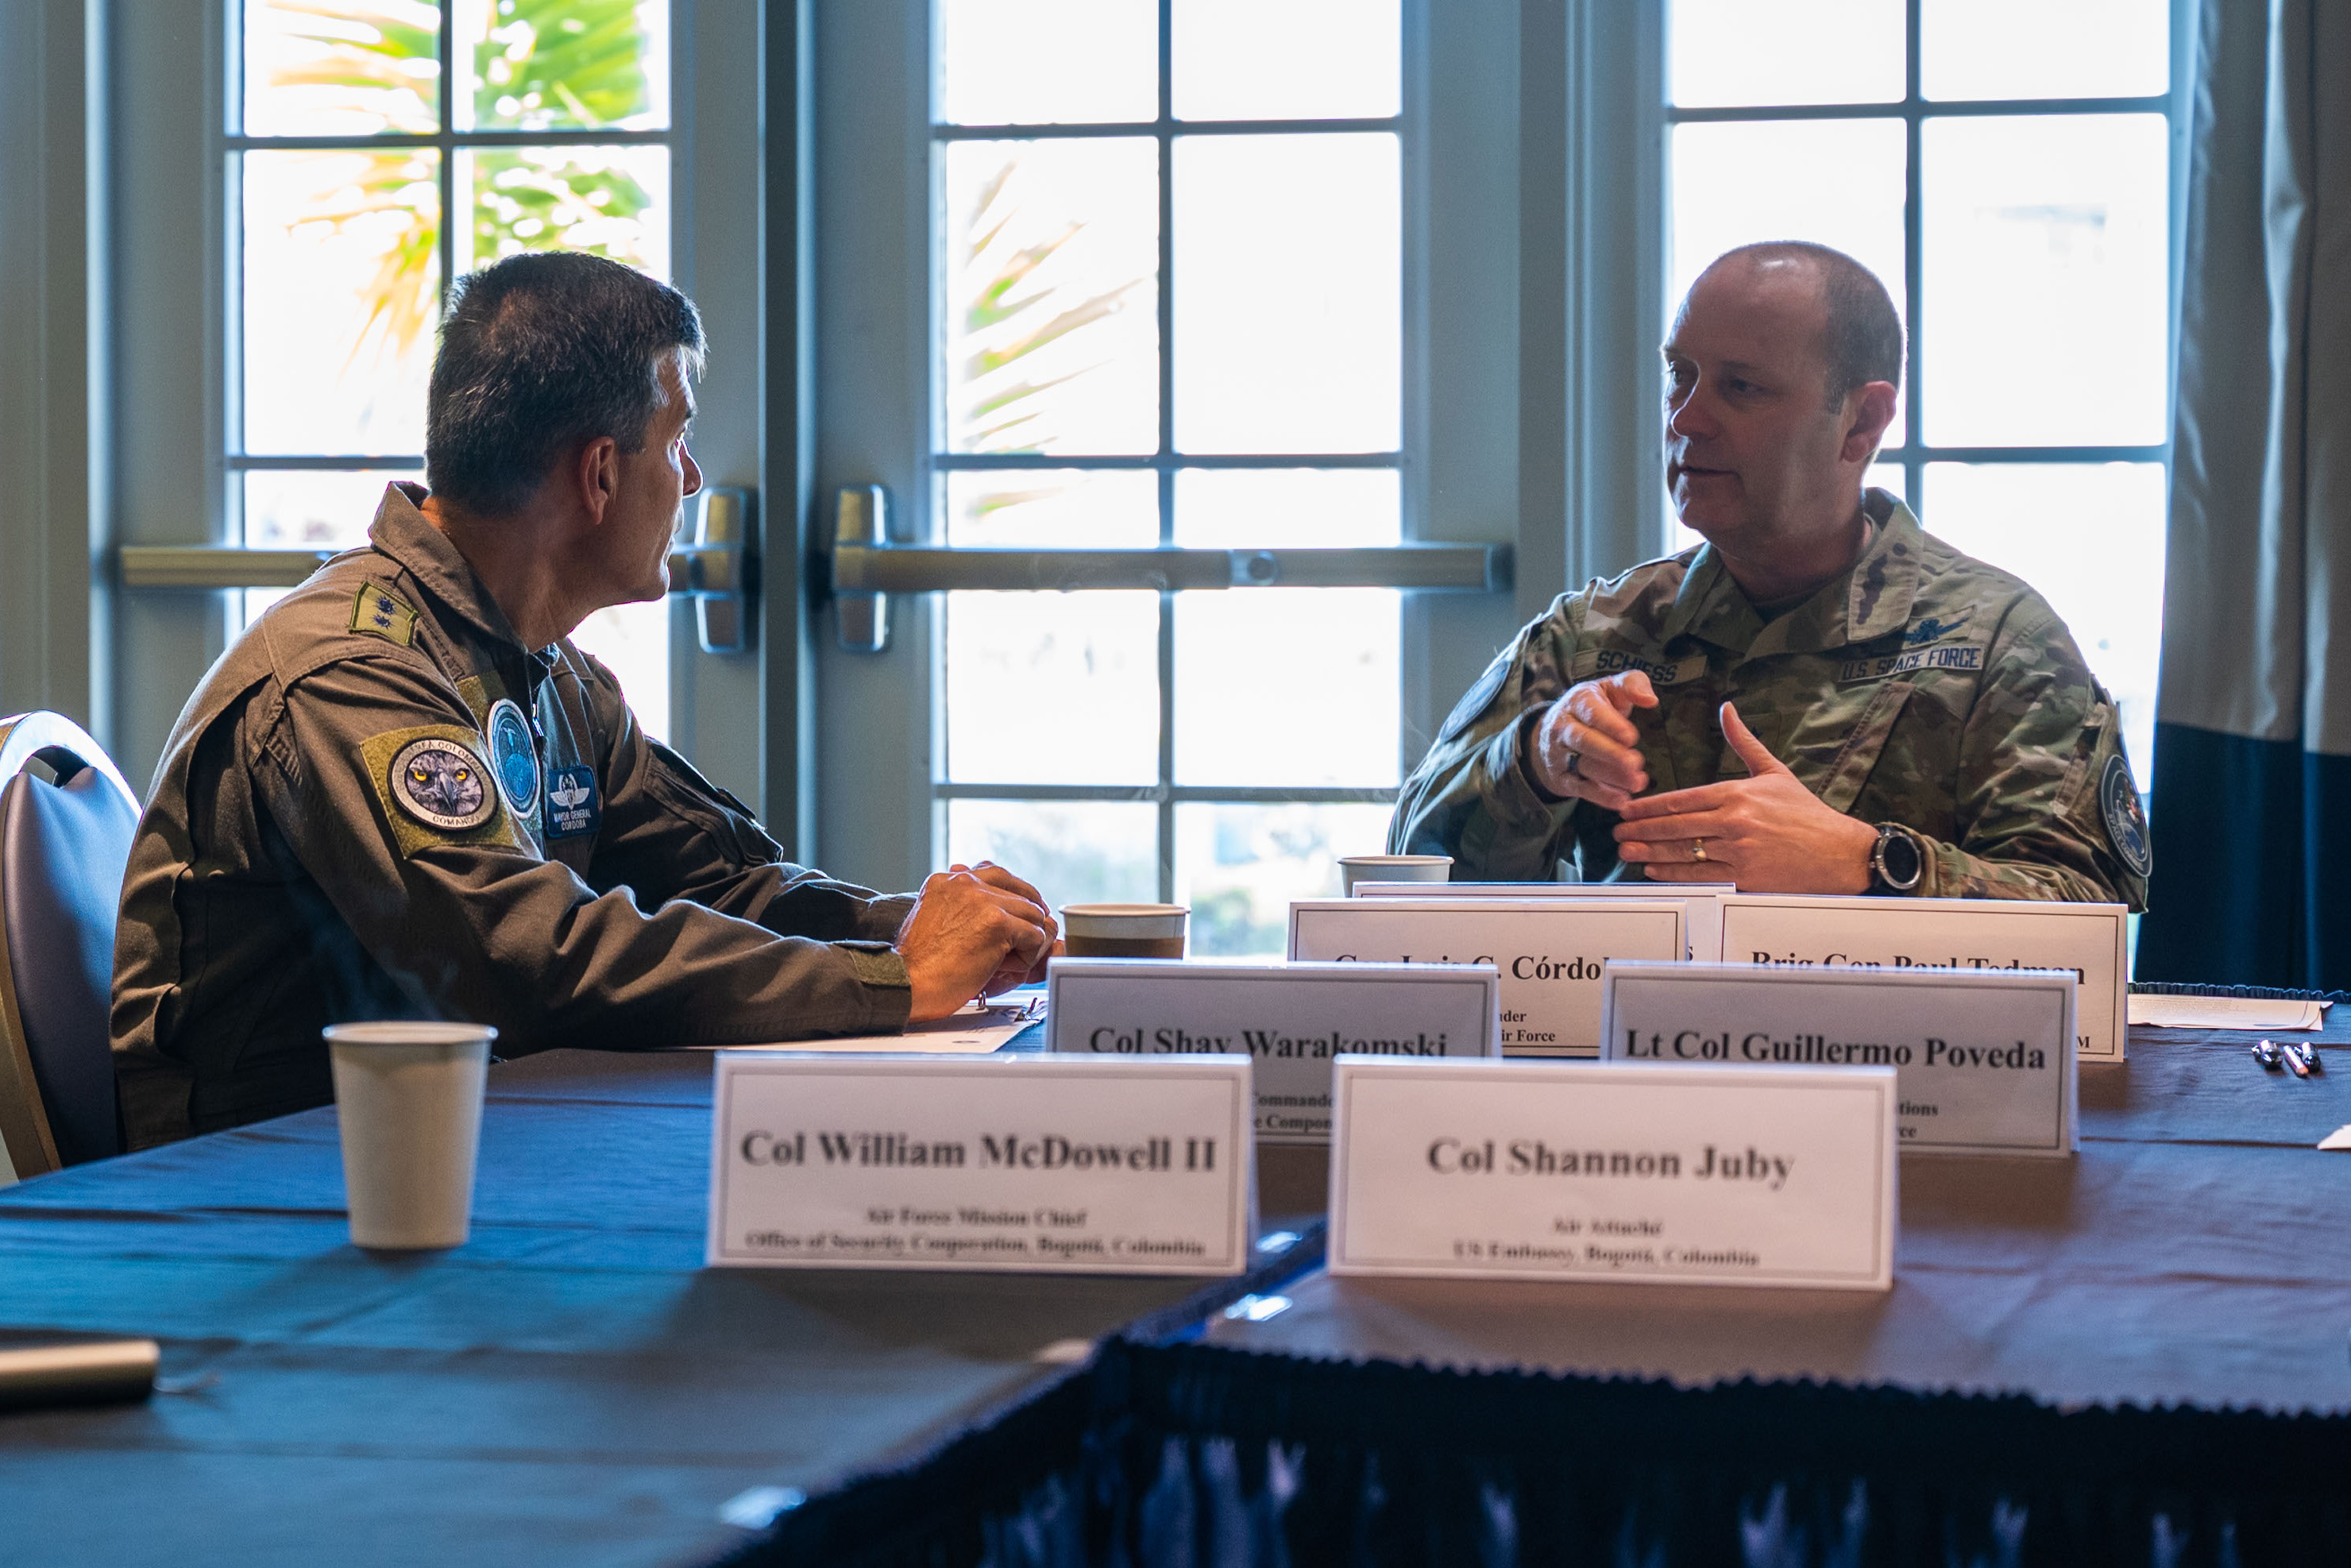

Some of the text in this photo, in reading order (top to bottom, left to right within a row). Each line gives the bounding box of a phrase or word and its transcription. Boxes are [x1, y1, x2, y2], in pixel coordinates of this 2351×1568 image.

[1596, 650, 1677, 682] SCHIESS
[1875, 653, 1925, 675] SPACE
[1927, 647, 1981, 668] FORCE
[570, 809, 591, 820] GENERAL
[1511, 956, 1610, 980] Córdo
[1090, 1027, 1144, 1053] Col
[1242, 1030, 1447, 1058] Warakomski
[1516, 1030, 1556, 1042] Force
[1627, 1029, 1663, 1057] Lt
[1673, 1030, 1730, 1060] Col
[1741, 1033, 1913, 1065] Guillermo
[1924, 1039, 2045, 1069] Poveda
[739, 1130, 1216, 1172] Col William McDowell II
[1426, 1137, 1793, 1192] Col Shannon Juby
